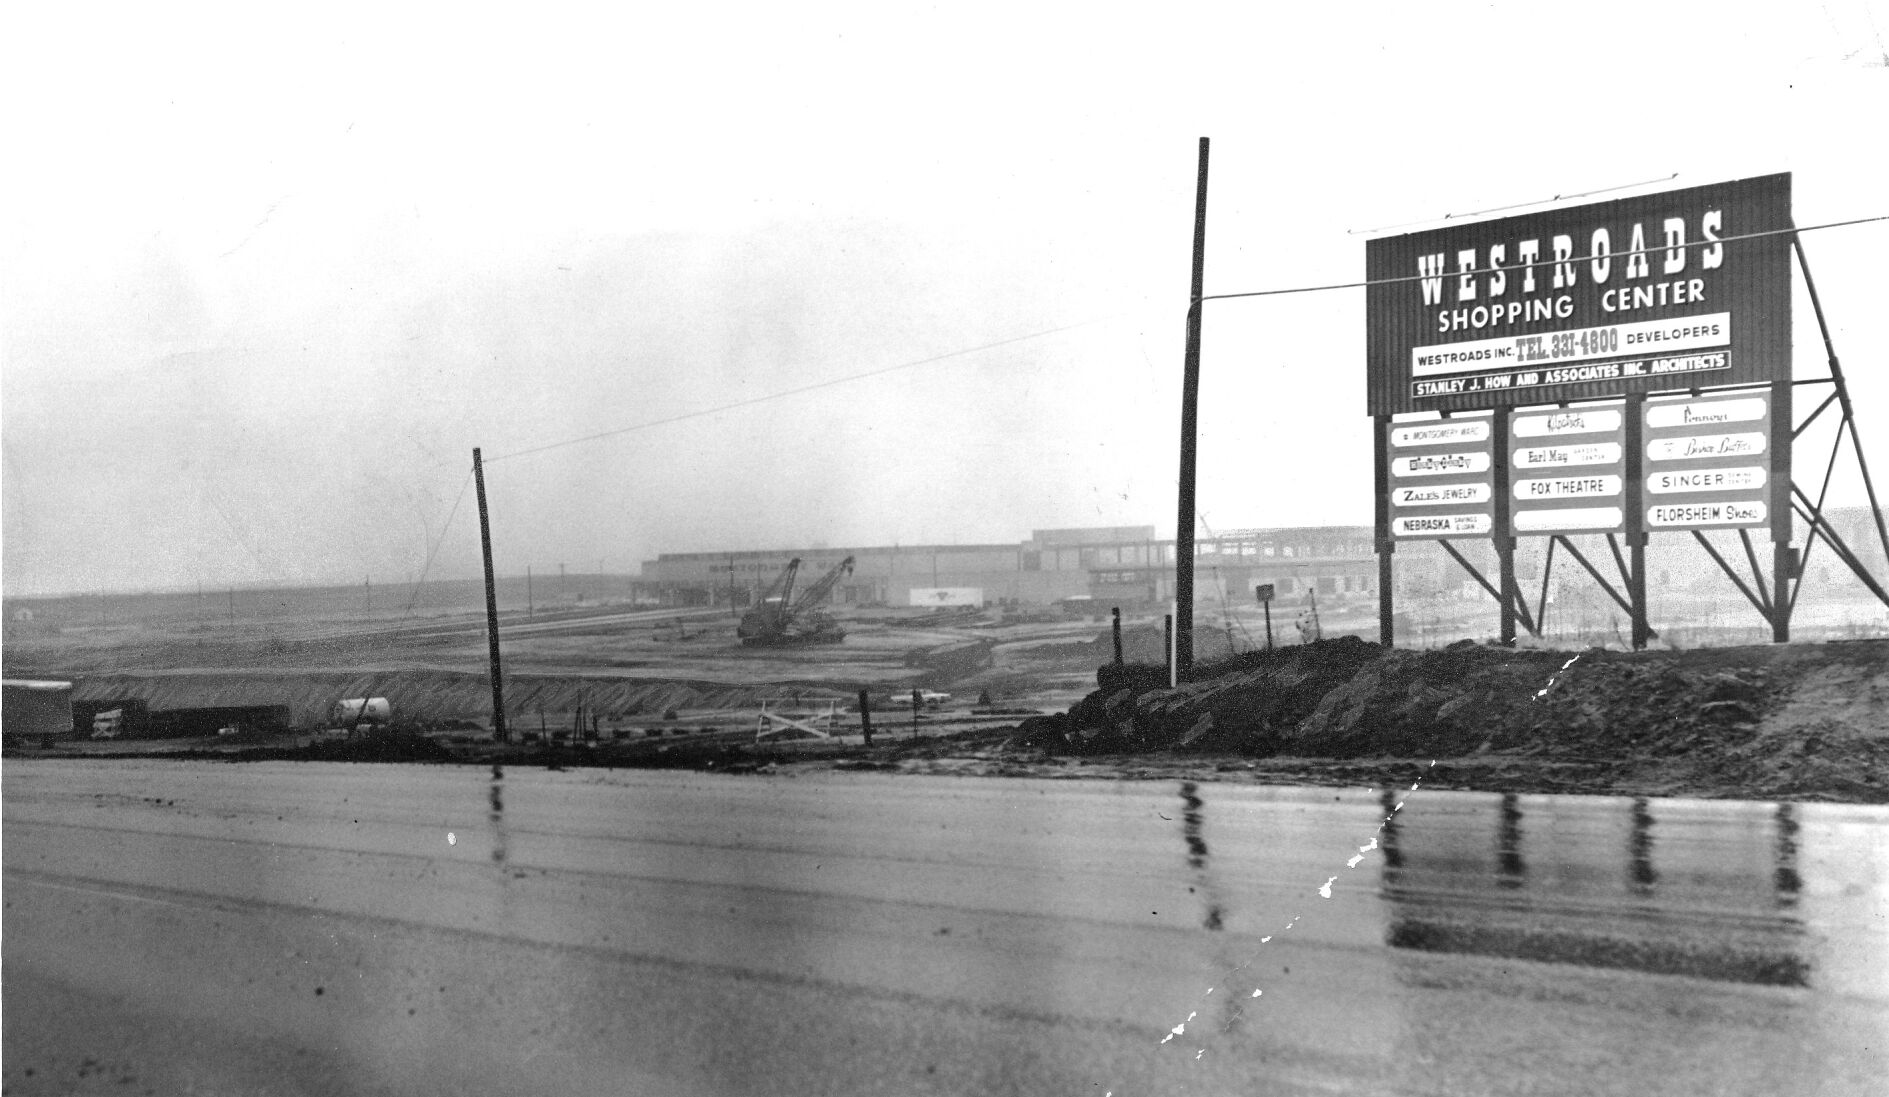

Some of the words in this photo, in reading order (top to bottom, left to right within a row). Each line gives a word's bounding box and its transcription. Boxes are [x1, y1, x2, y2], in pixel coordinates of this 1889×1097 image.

[1418, 210, 1723, 305] WESTROADS
[1438, 296, 1574, 332] SHOPPING
[1602, 278, 1705, 312] CENTER
[1417, 349, 1492, 367] WESTROADS
[1494, 347, 1515, 358] INC.
[1516, 336, 1550, 362] TEL.
[1626, 324, 1720, 345] DEVELOPERS
[1416, 379, 1466, 396] STANLEY
[1469, 378, 1481, 391] J.
[1484, 375, 1511, 389] HOW
[1516, 372, 1539, 386] AND
[1545, 364, 1619, 384] ASSOCIATES
[1623, 362, 1647, 376] INC.
[1651, 353, 1726, 374] ARCHITECTS
[1528, 450, 1547, 463] Earl
[1531, 482, 1551, 495] FOX
[1555, 479, 1604, 494] THEATRE
[1662, 474, 1724, 488] SINGER
[1441, 487, 1478, 500] JEWELRY
[1656, 507, 1721, 522] FLORSHEIM
[1403, 519, 1451, 531] NEBRASKA
